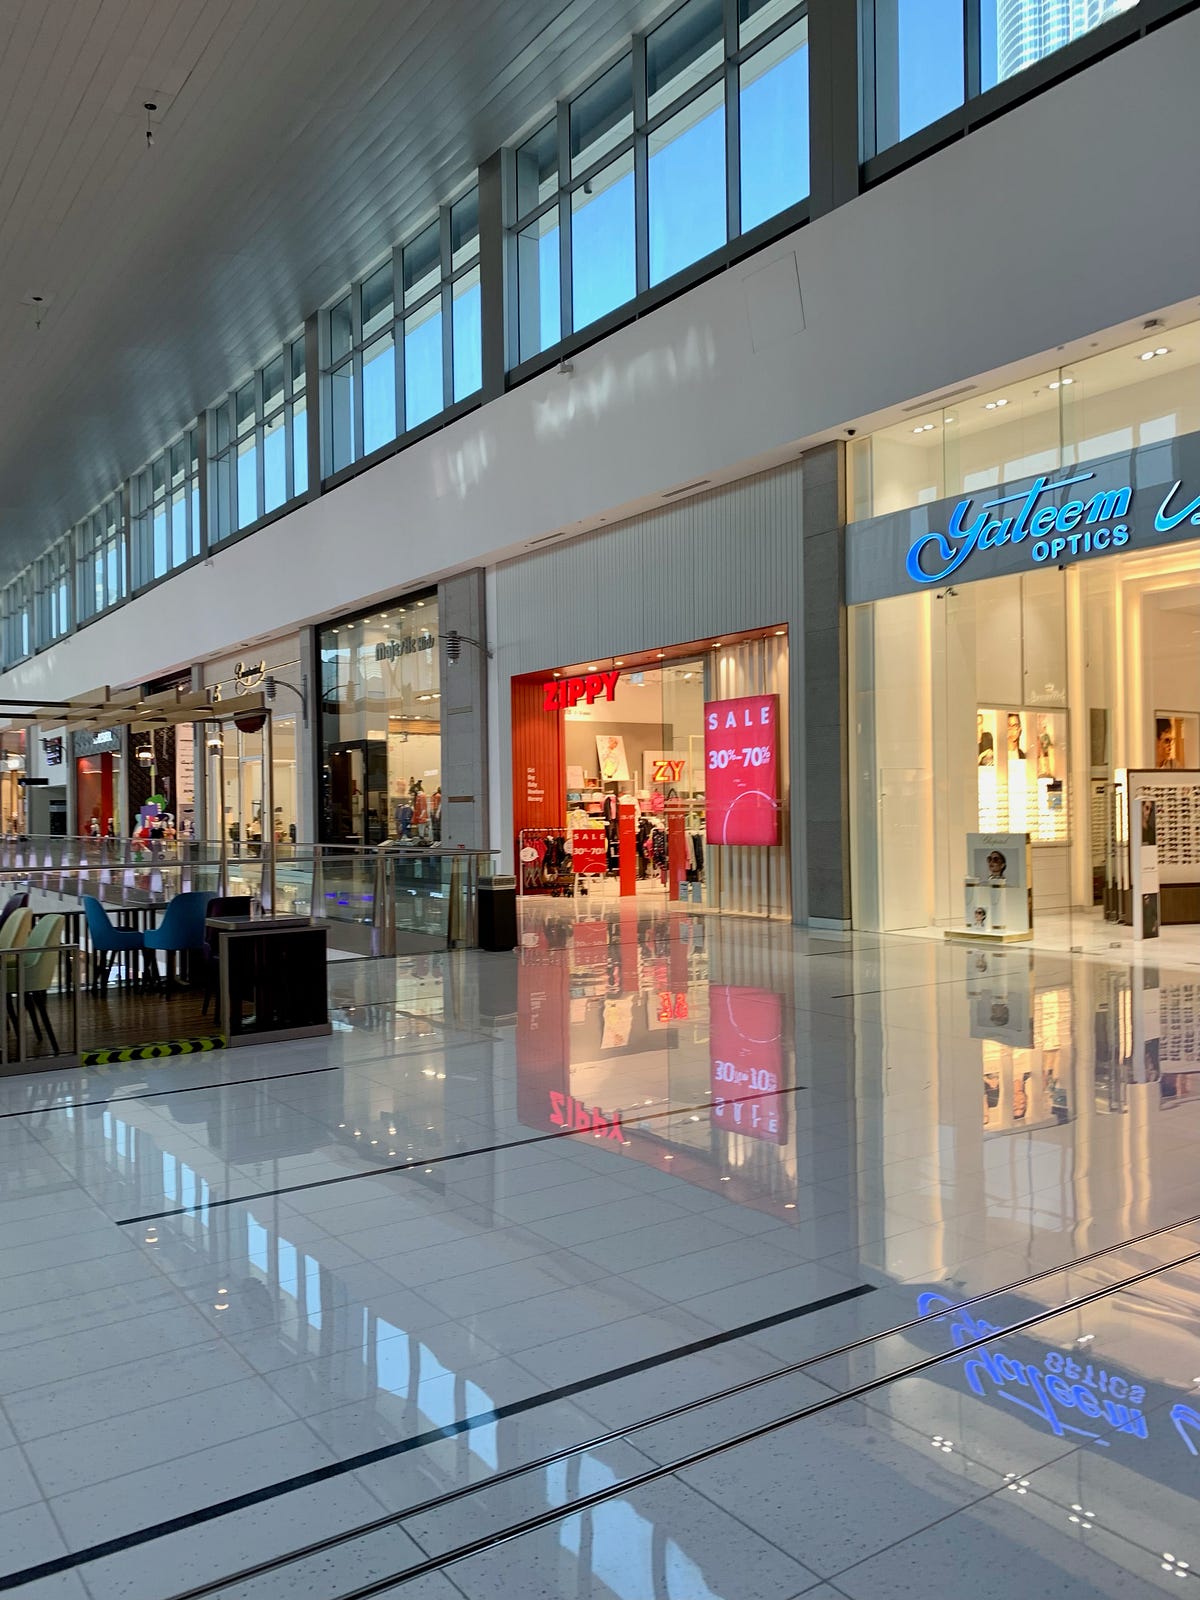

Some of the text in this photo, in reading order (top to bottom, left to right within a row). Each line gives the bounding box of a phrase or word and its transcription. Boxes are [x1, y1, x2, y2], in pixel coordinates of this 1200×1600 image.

[906, 472, 1132, 583] Yateem
[1032, 524, 1130, 562] OPTICS
[543, 671, 620, 711] ZIPPY
[708, 706, 770, 731] SALE
[653, 760, 685, 781] ZY
